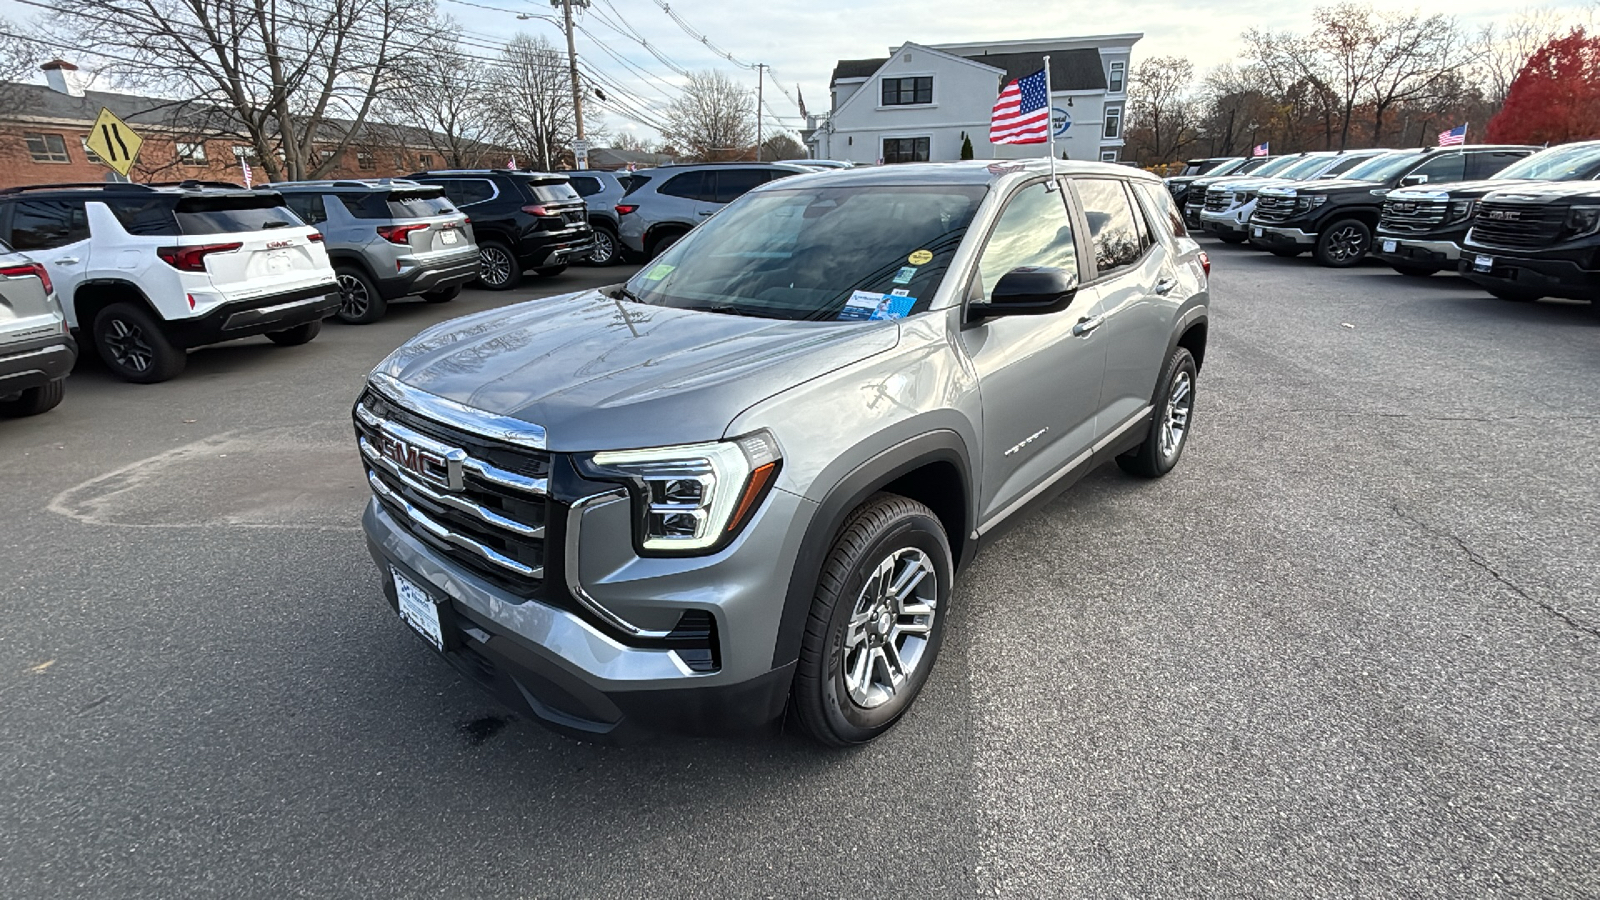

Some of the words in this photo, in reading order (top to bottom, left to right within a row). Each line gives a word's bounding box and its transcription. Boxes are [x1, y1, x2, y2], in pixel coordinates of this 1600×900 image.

[1489, 211, 1521, 220] GMC
[266, 240, 293, 249] GMC
[379, 431, 448, 486] GMC
